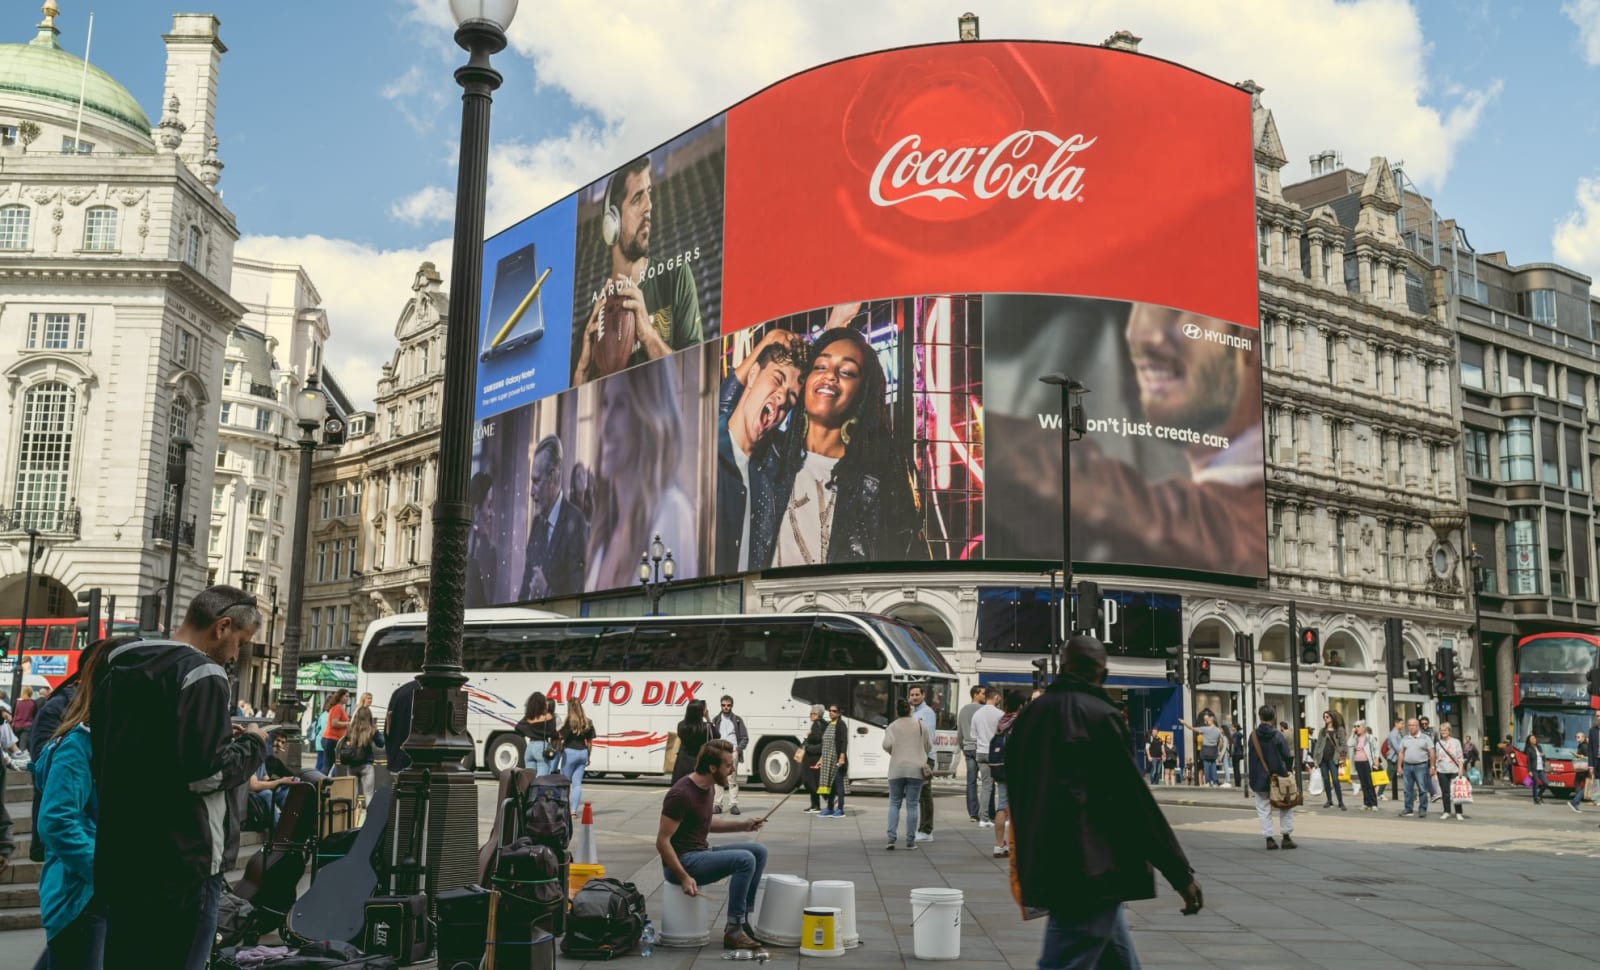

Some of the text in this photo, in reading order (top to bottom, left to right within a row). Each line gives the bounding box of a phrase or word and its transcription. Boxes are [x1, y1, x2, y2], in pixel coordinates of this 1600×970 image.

[869, 130, 1098, 206] Coca-Cola
[591, 247, 700, 303] AARON RODGERS
[1204, 329, 1252, 351] HYUNDAI
[1086, 416, 1119, 433] on't
[1122, 417, 1152, 437] just
[1155, 424, 1200, 444] create
[1202, 433, 1229, 449] cars
[1061, 597, 1118, 644] GP
[546, 680, 703, 706] AUTO DIX
[375, 921, 390, 946] AER
